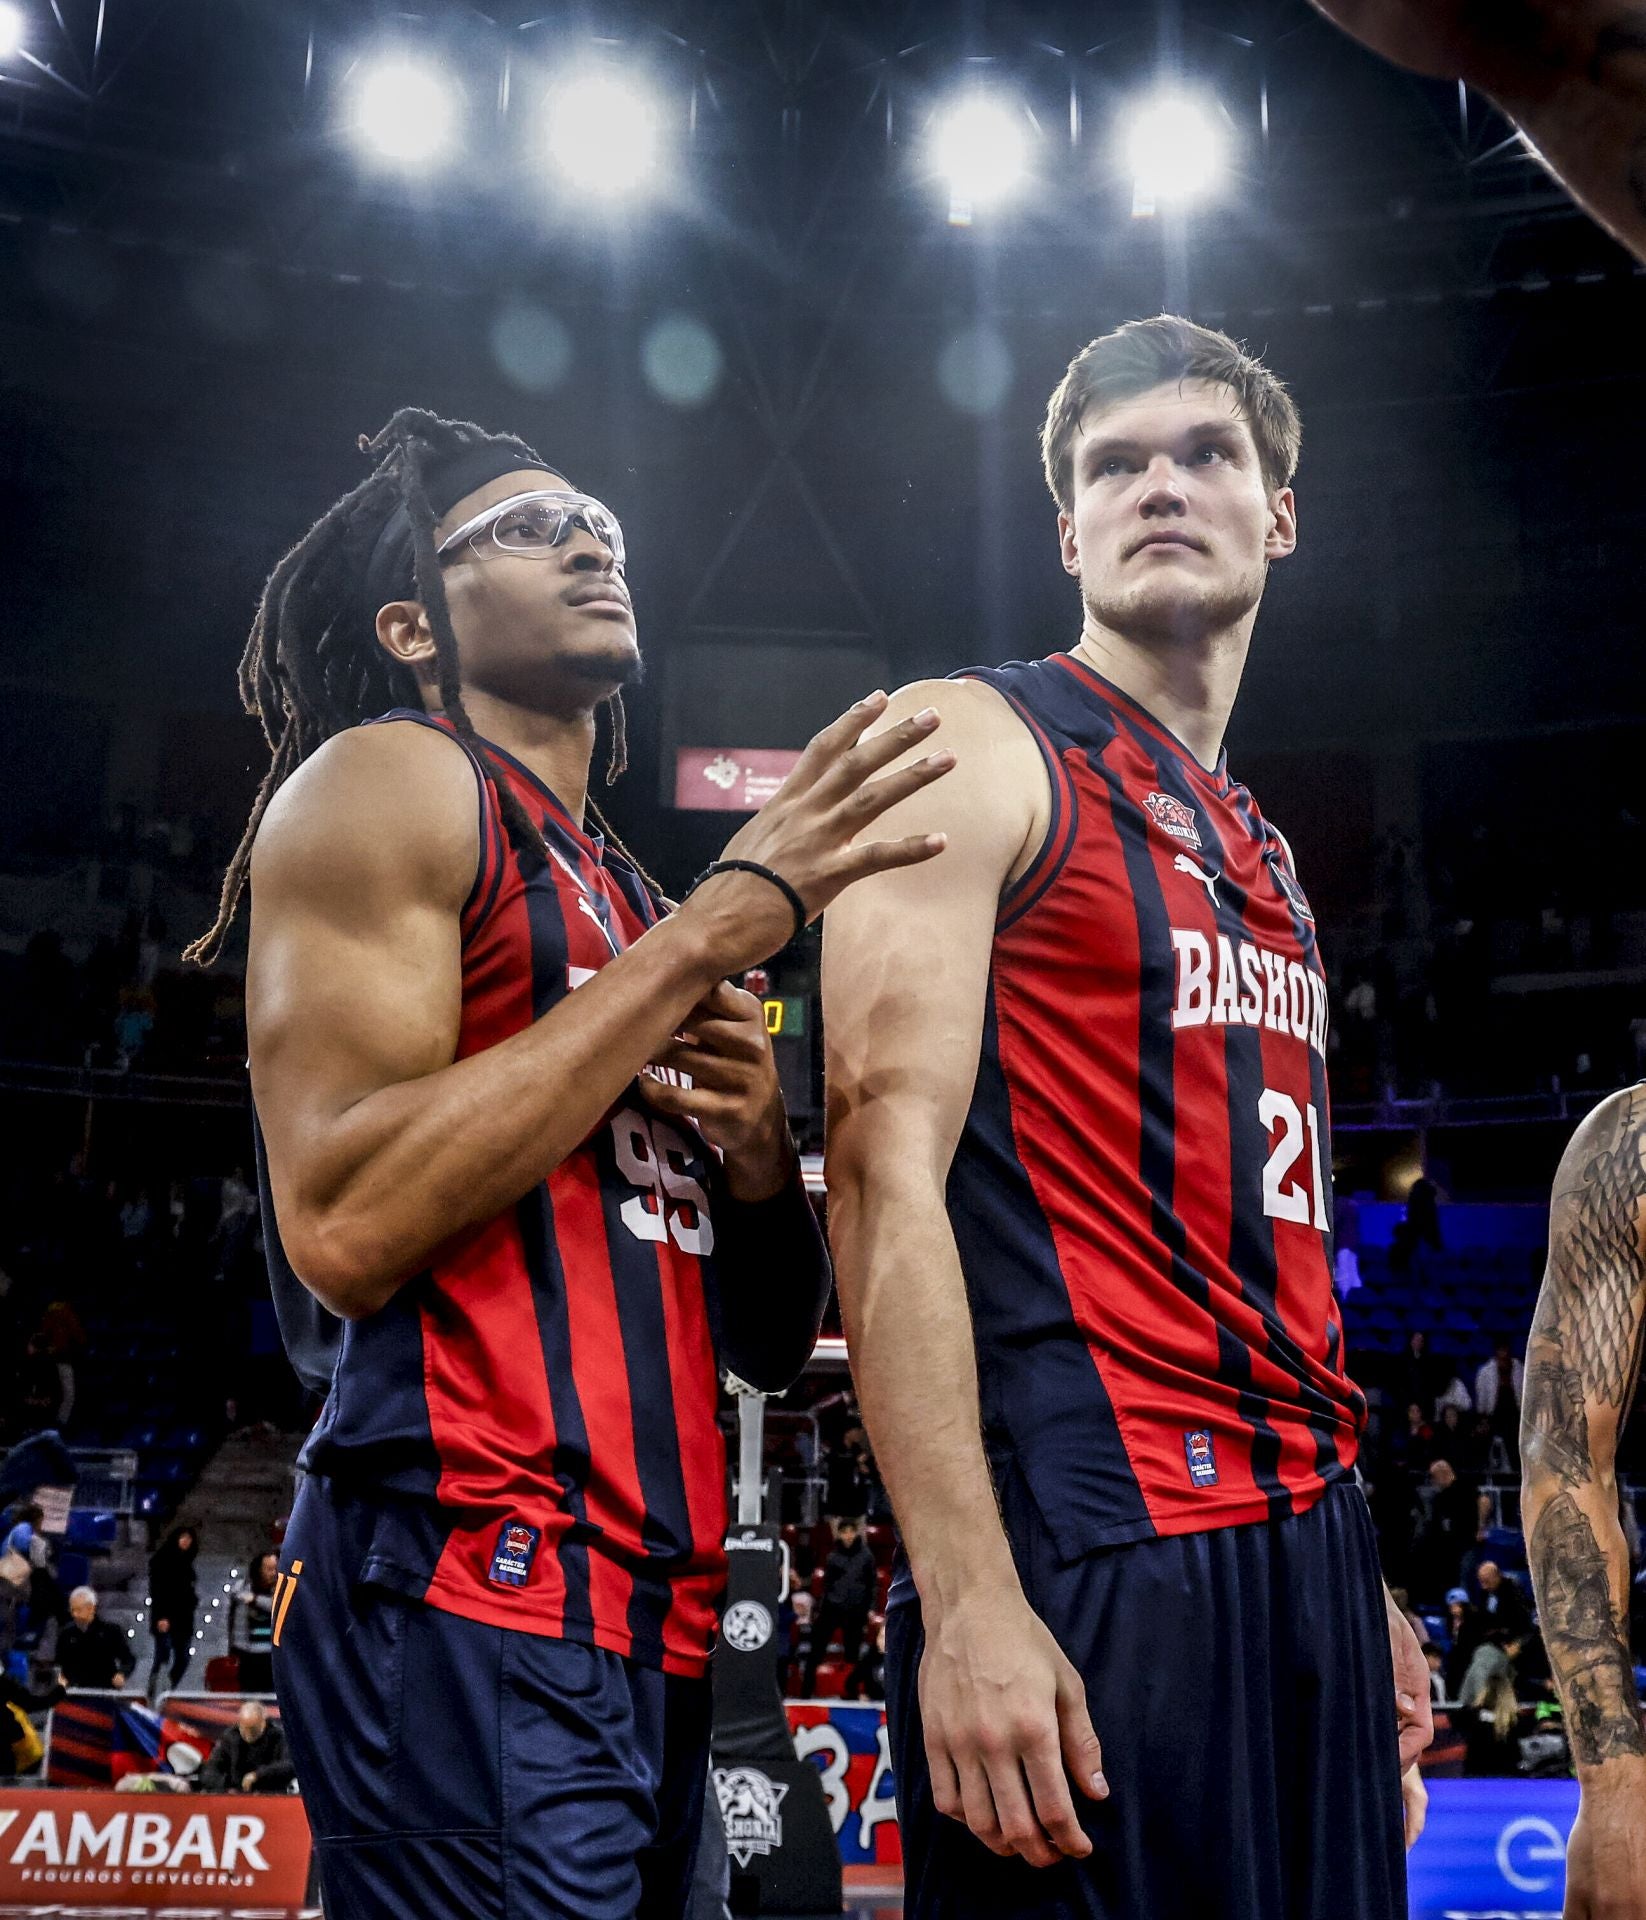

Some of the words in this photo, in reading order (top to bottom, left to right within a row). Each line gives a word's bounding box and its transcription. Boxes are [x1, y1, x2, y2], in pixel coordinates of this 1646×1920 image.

[1171, 929, 1329, 1064] BASKON
[611, 1106, 714, 1257] 95
[1257, 1087, 1331, 1233] 21
[9, 1810, 271, 1871] AMBAR
